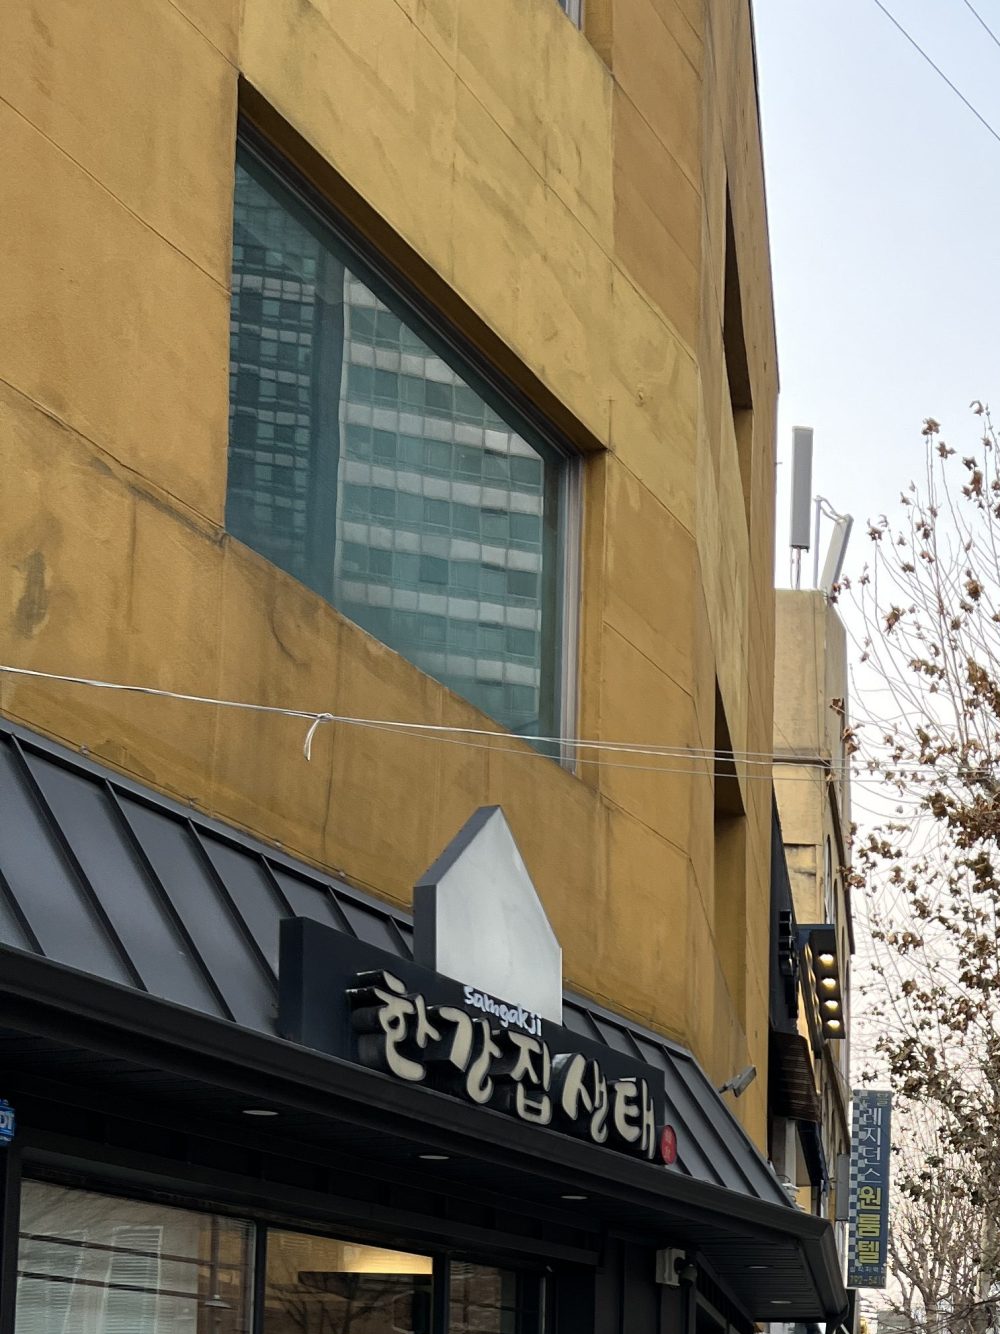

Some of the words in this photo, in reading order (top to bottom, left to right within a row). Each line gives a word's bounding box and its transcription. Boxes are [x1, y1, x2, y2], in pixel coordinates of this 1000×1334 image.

[373, 970, 552, 1126] 한강집
[562, 1053, 656, 1160] 생태
[863, 1107, 882, 1183] 레지던스
[858, 1186, 881, 1264] 원룸텔
